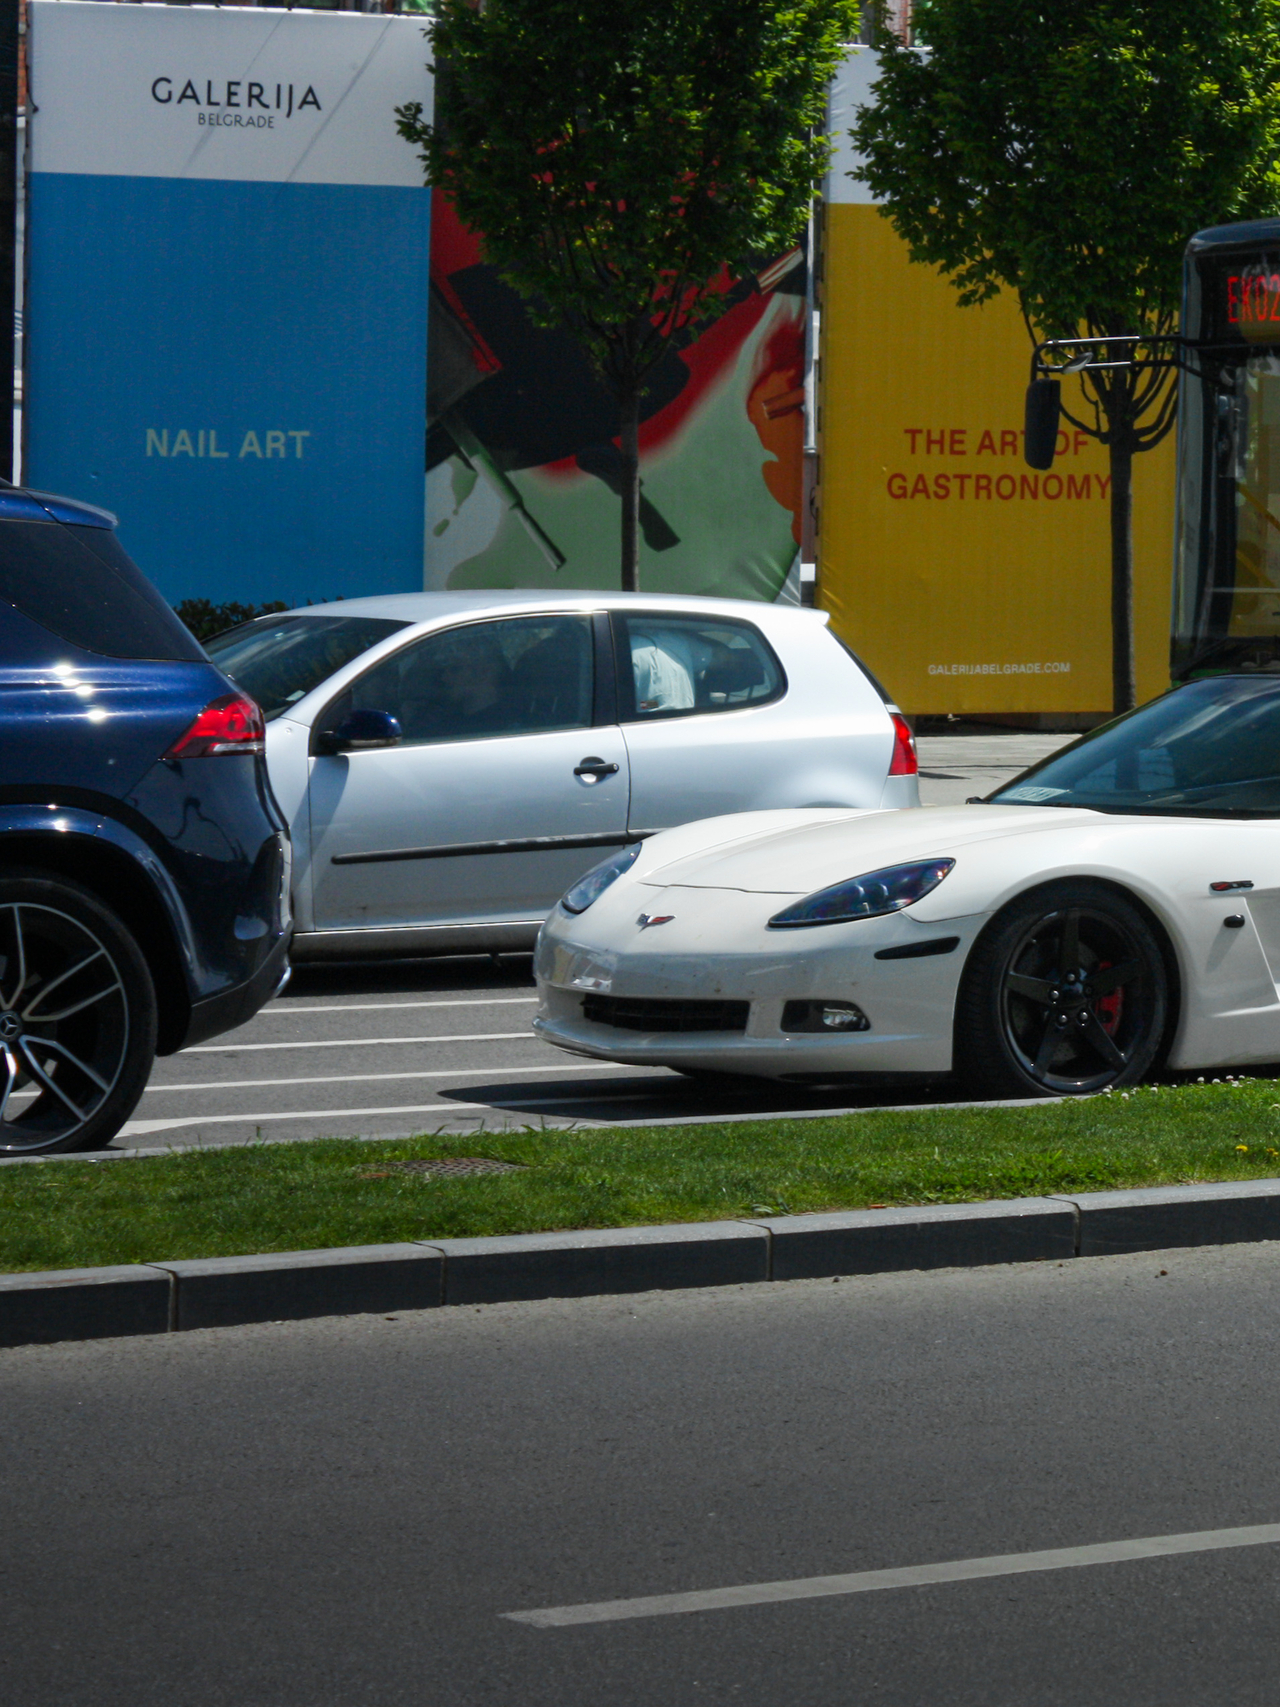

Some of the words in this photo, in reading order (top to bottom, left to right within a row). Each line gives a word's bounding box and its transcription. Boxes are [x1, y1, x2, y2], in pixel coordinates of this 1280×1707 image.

[151, 76, 322, 119] GALERIJA
[198, 112, 275, 129] BELGRADE
[146, 428, 229, 458] NAIL
[238, 430, 310, 459] ART
[904, 429, 967, 456] THE
[976, 430, 1025, 456] AR
[887, 473, 1112, 500] GASTRONOMY
[928, 662, 1070, 675] GALERIJABELGRADE.COM
